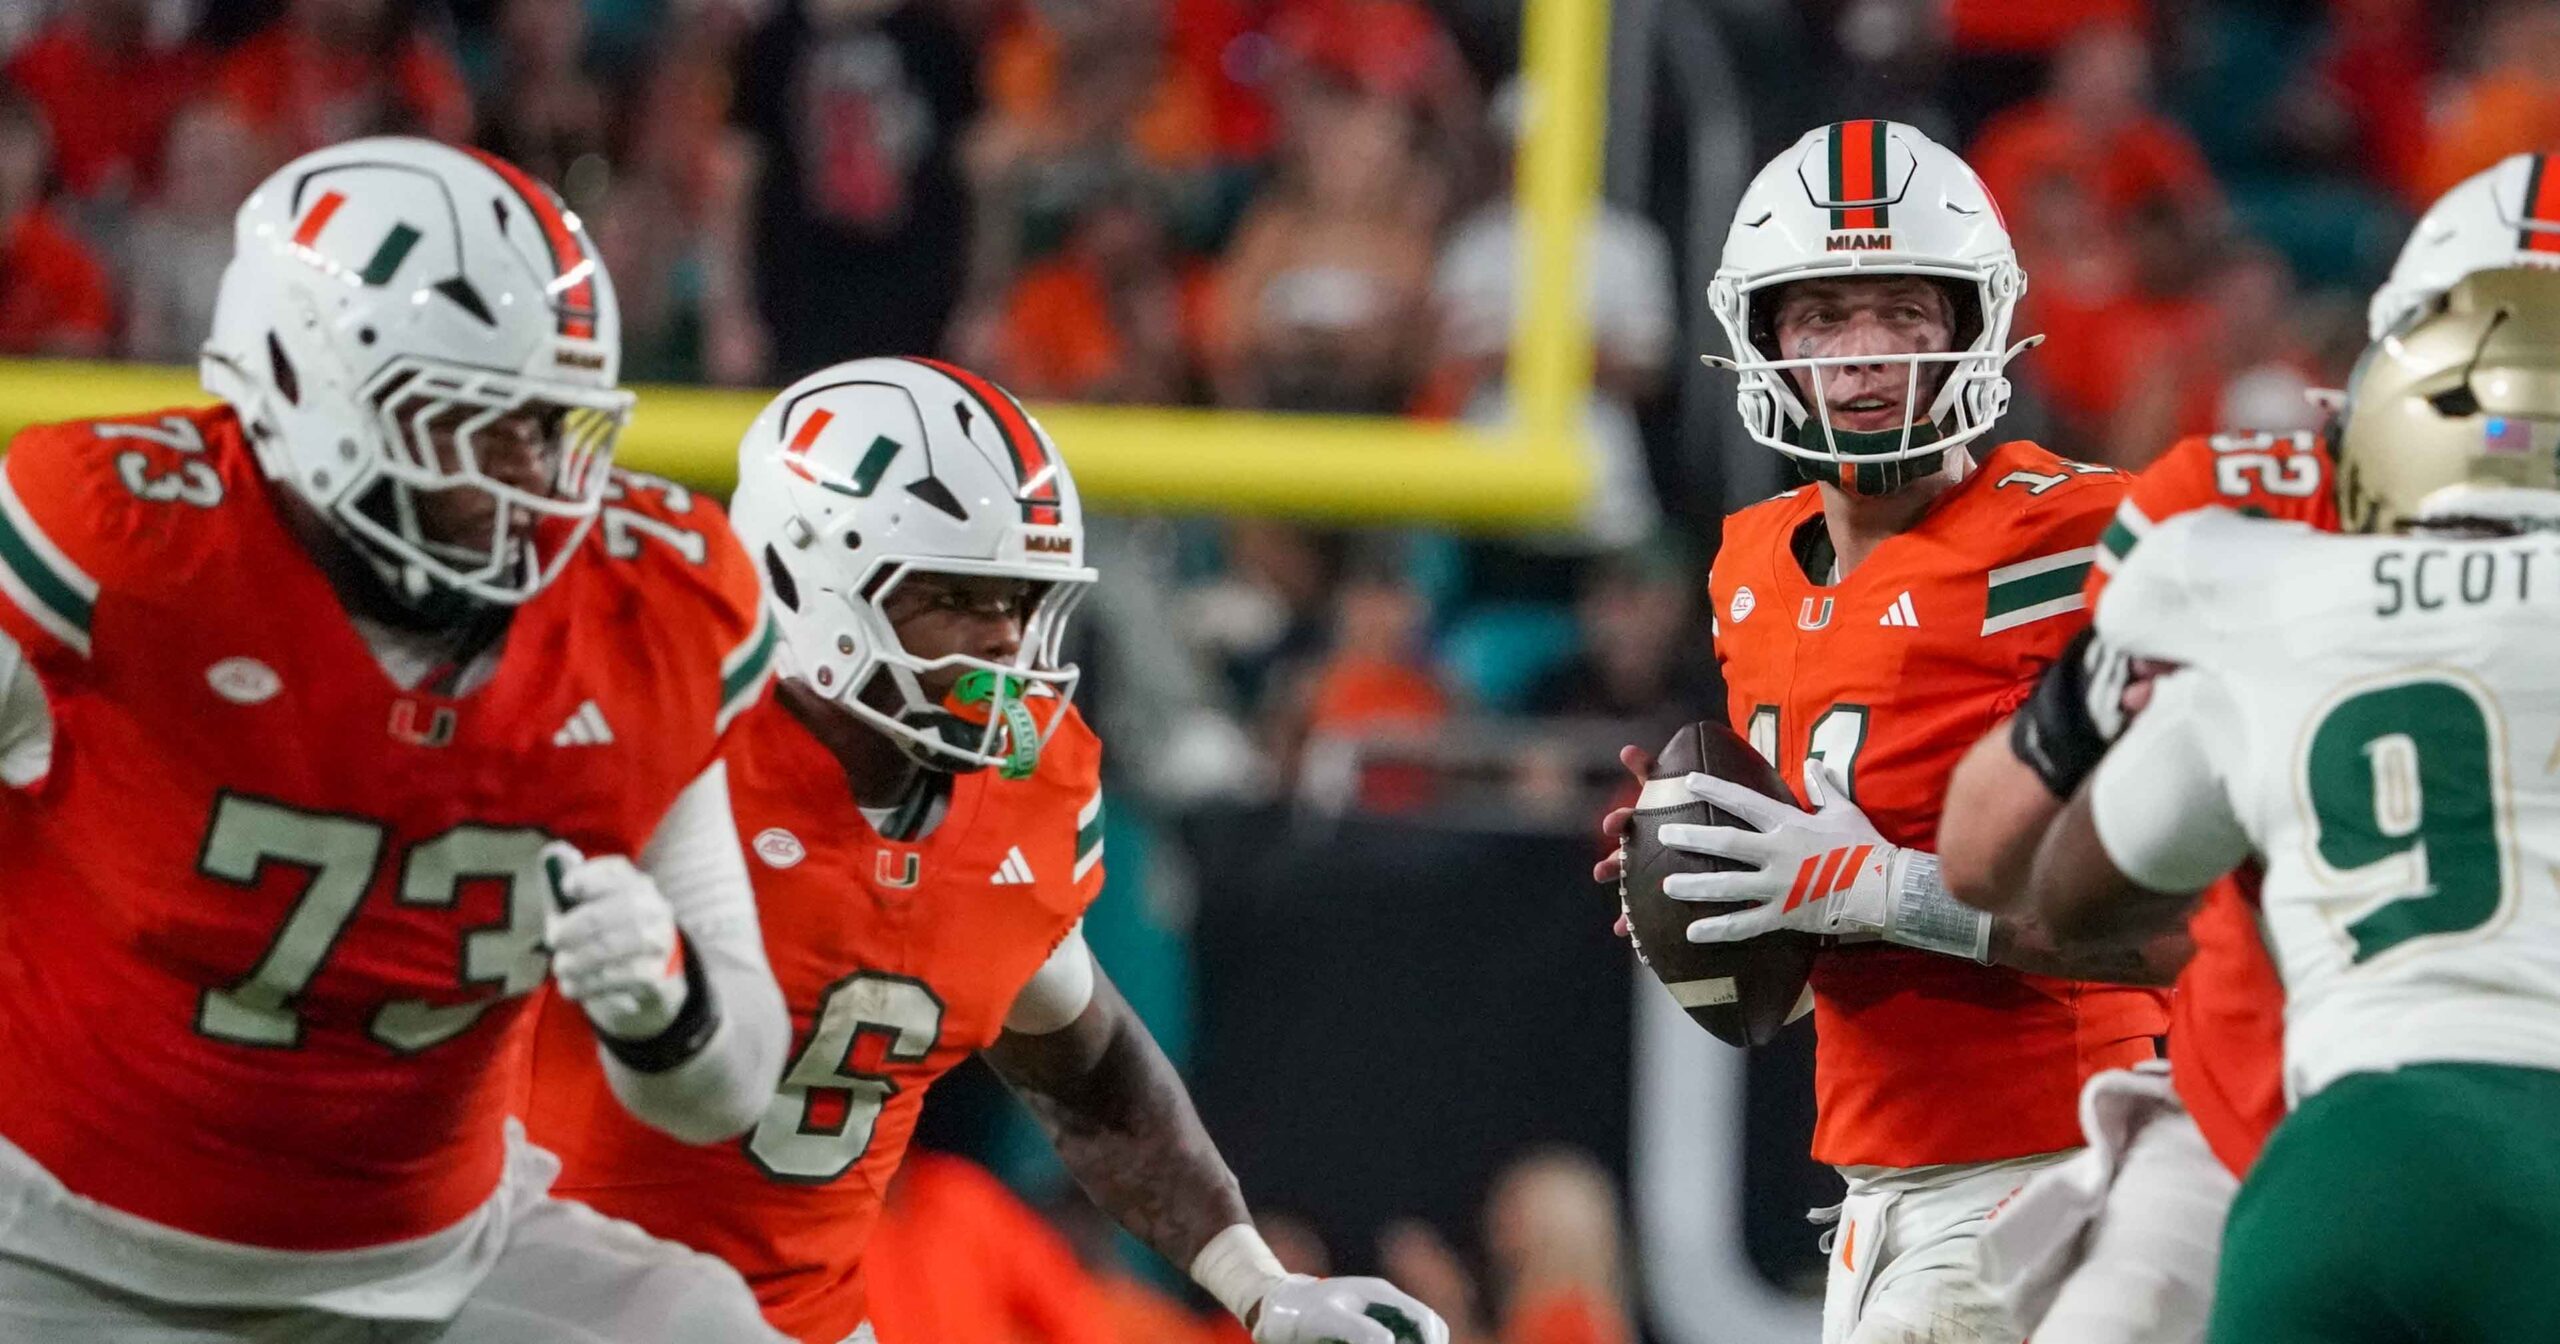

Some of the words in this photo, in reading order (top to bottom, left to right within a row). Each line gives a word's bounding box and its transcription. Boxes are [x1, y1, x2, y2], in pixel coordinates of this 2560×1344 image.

[1826, 234, 1892, 251] MIAMI
[92, 415, 223, 507] 73
[784, 408, 903, 498] U
[1025, 534, 1072, 554] MIAMI
[2373, 548, 2560, 617] SCOT
[1797, 596, 1835, 631] U
[387, 699, 457, 748] U
[875, 849, 920, 889] U
[196, 788, 553, 1058] 73
[740, 967, 945, 1187] 6
